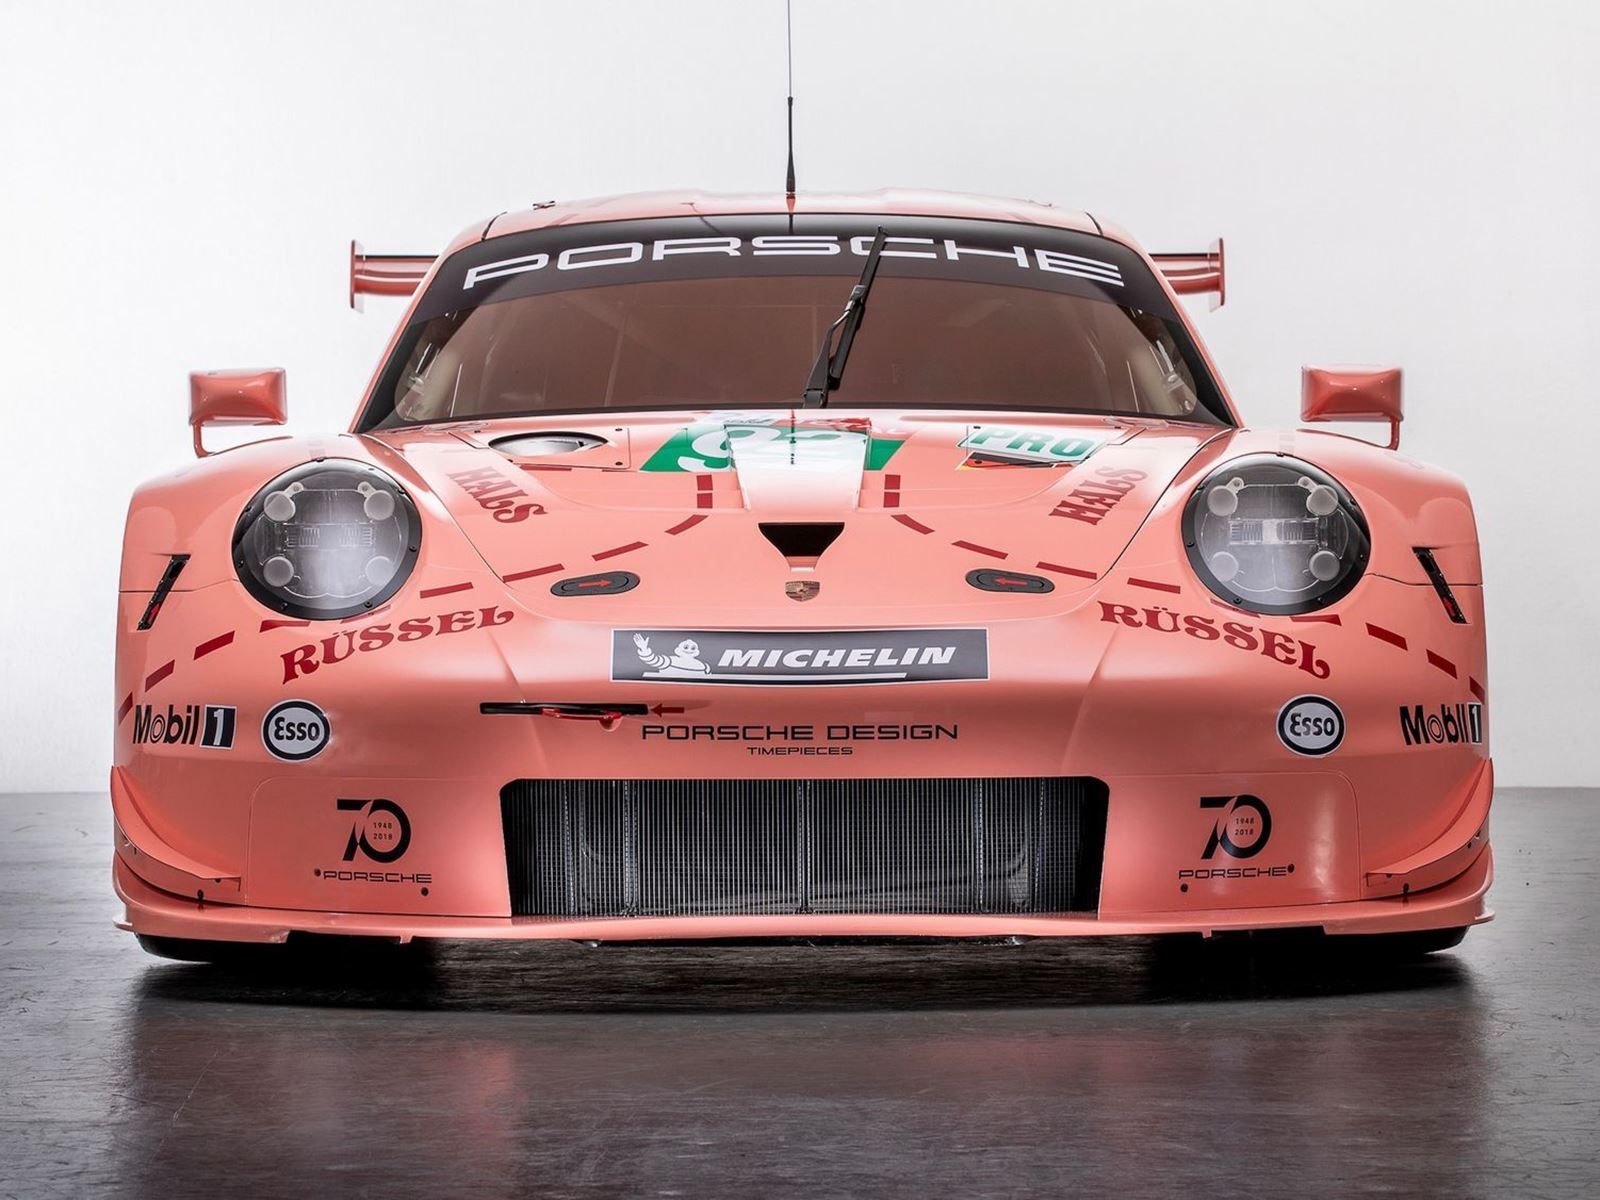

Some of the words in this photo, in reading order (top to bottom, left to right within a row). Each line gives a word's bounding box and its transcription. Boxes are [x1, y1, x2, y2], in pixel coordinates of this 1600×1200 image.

[463, 235, 1124, 290] PORSCHE
[970, 427, 1096, 457] PRO
[280, 606, 514, 684] RÜSSEL
[1097, 600, 1330, 679] RÜSSEL
[717, 646, 956, 668] MICHELIN
[133, 704, 200, 744] Mobil
[273, 716, 321, 741] Esso
[642, 725, 814, 741] PORSCHE
[827, 724, 958, 740] DESIGN
[1289, 713, 1335, 736] Esso
[1400, 704, 1469, 745] Mobil
[747, 747, 853, 756] TIMEPIECES
[337, 798, 411, 863] 70
[1200, 794, 1272, 859] 70
[323, 871, 432, 883] PORSCHE
[1178, 866, 1287, 880] PORSCHE
